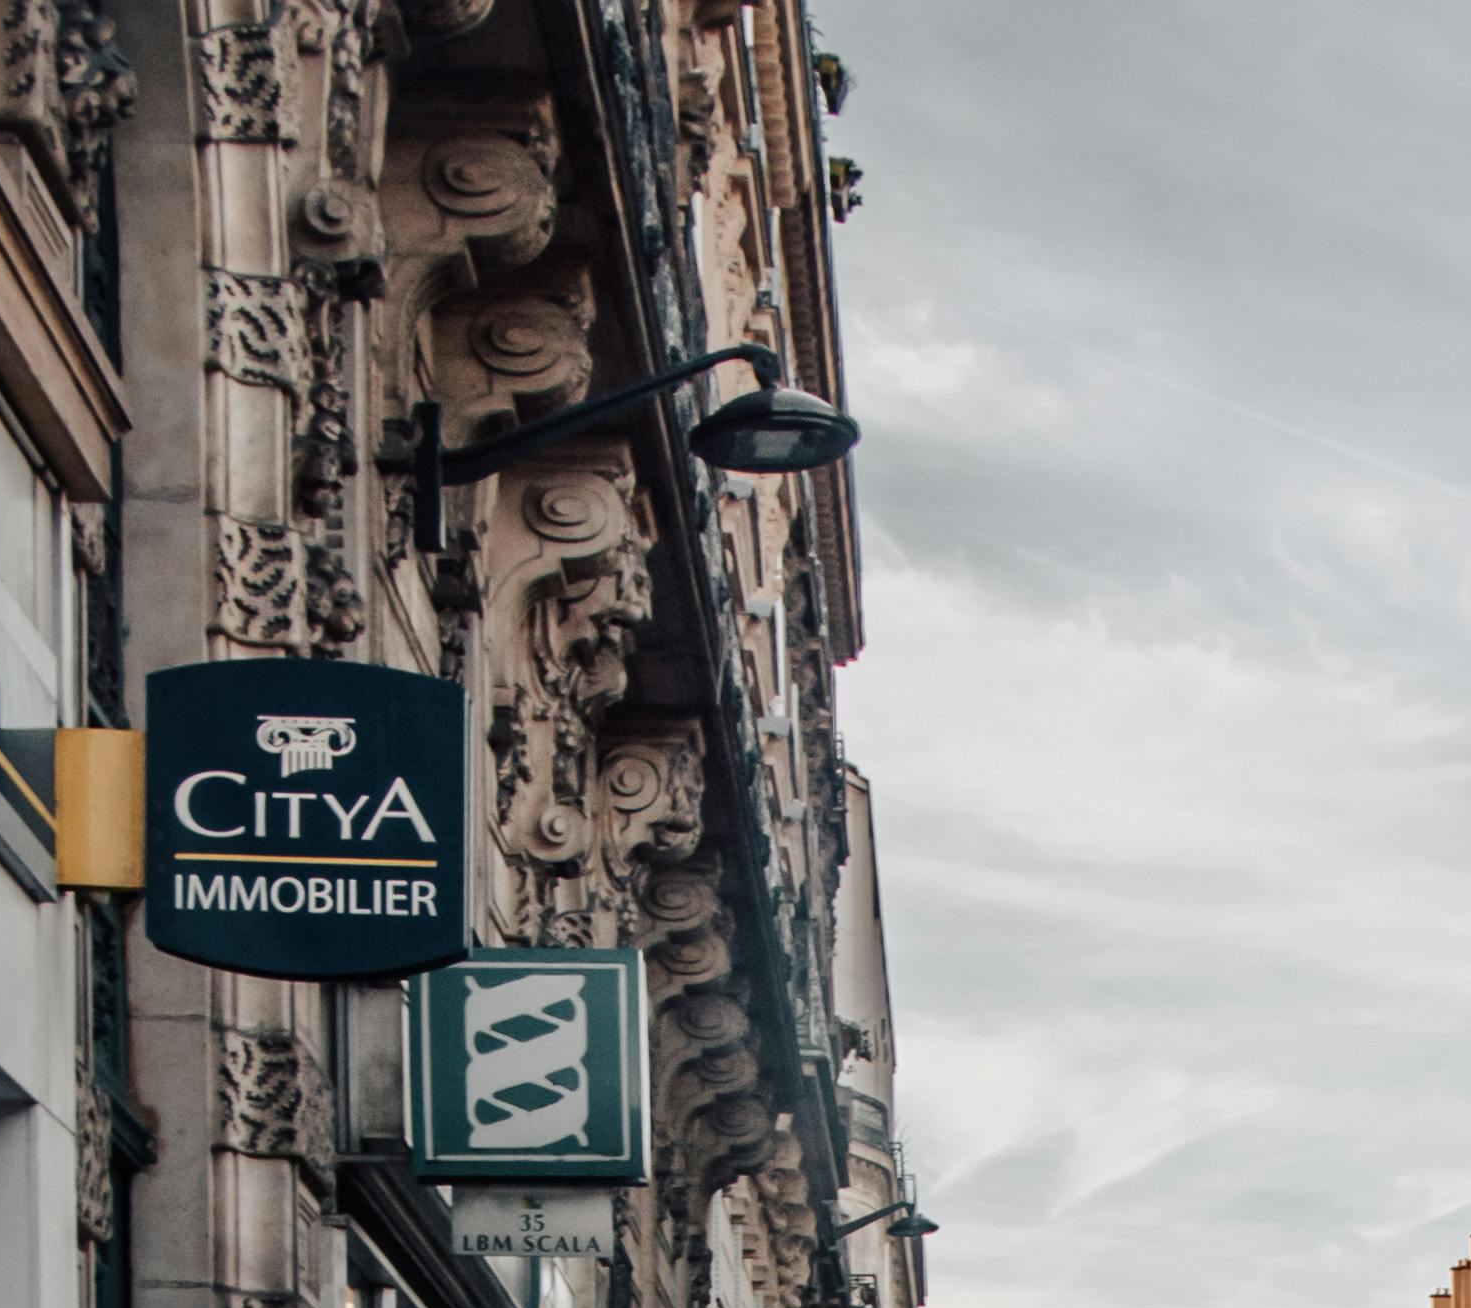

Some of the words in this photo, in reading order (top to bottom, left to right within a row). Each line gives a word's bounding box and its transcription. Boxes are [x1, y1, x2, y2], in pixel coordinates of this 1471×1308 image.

[174, 770, 437, 844] CITYA
[174, 874, 438, 917] IMMOBILIER
[519, 1214, 545, 1232] 35
[463, 1235, 511, 1252] LBM
[524, 1235, 601, 1252] SCALA
